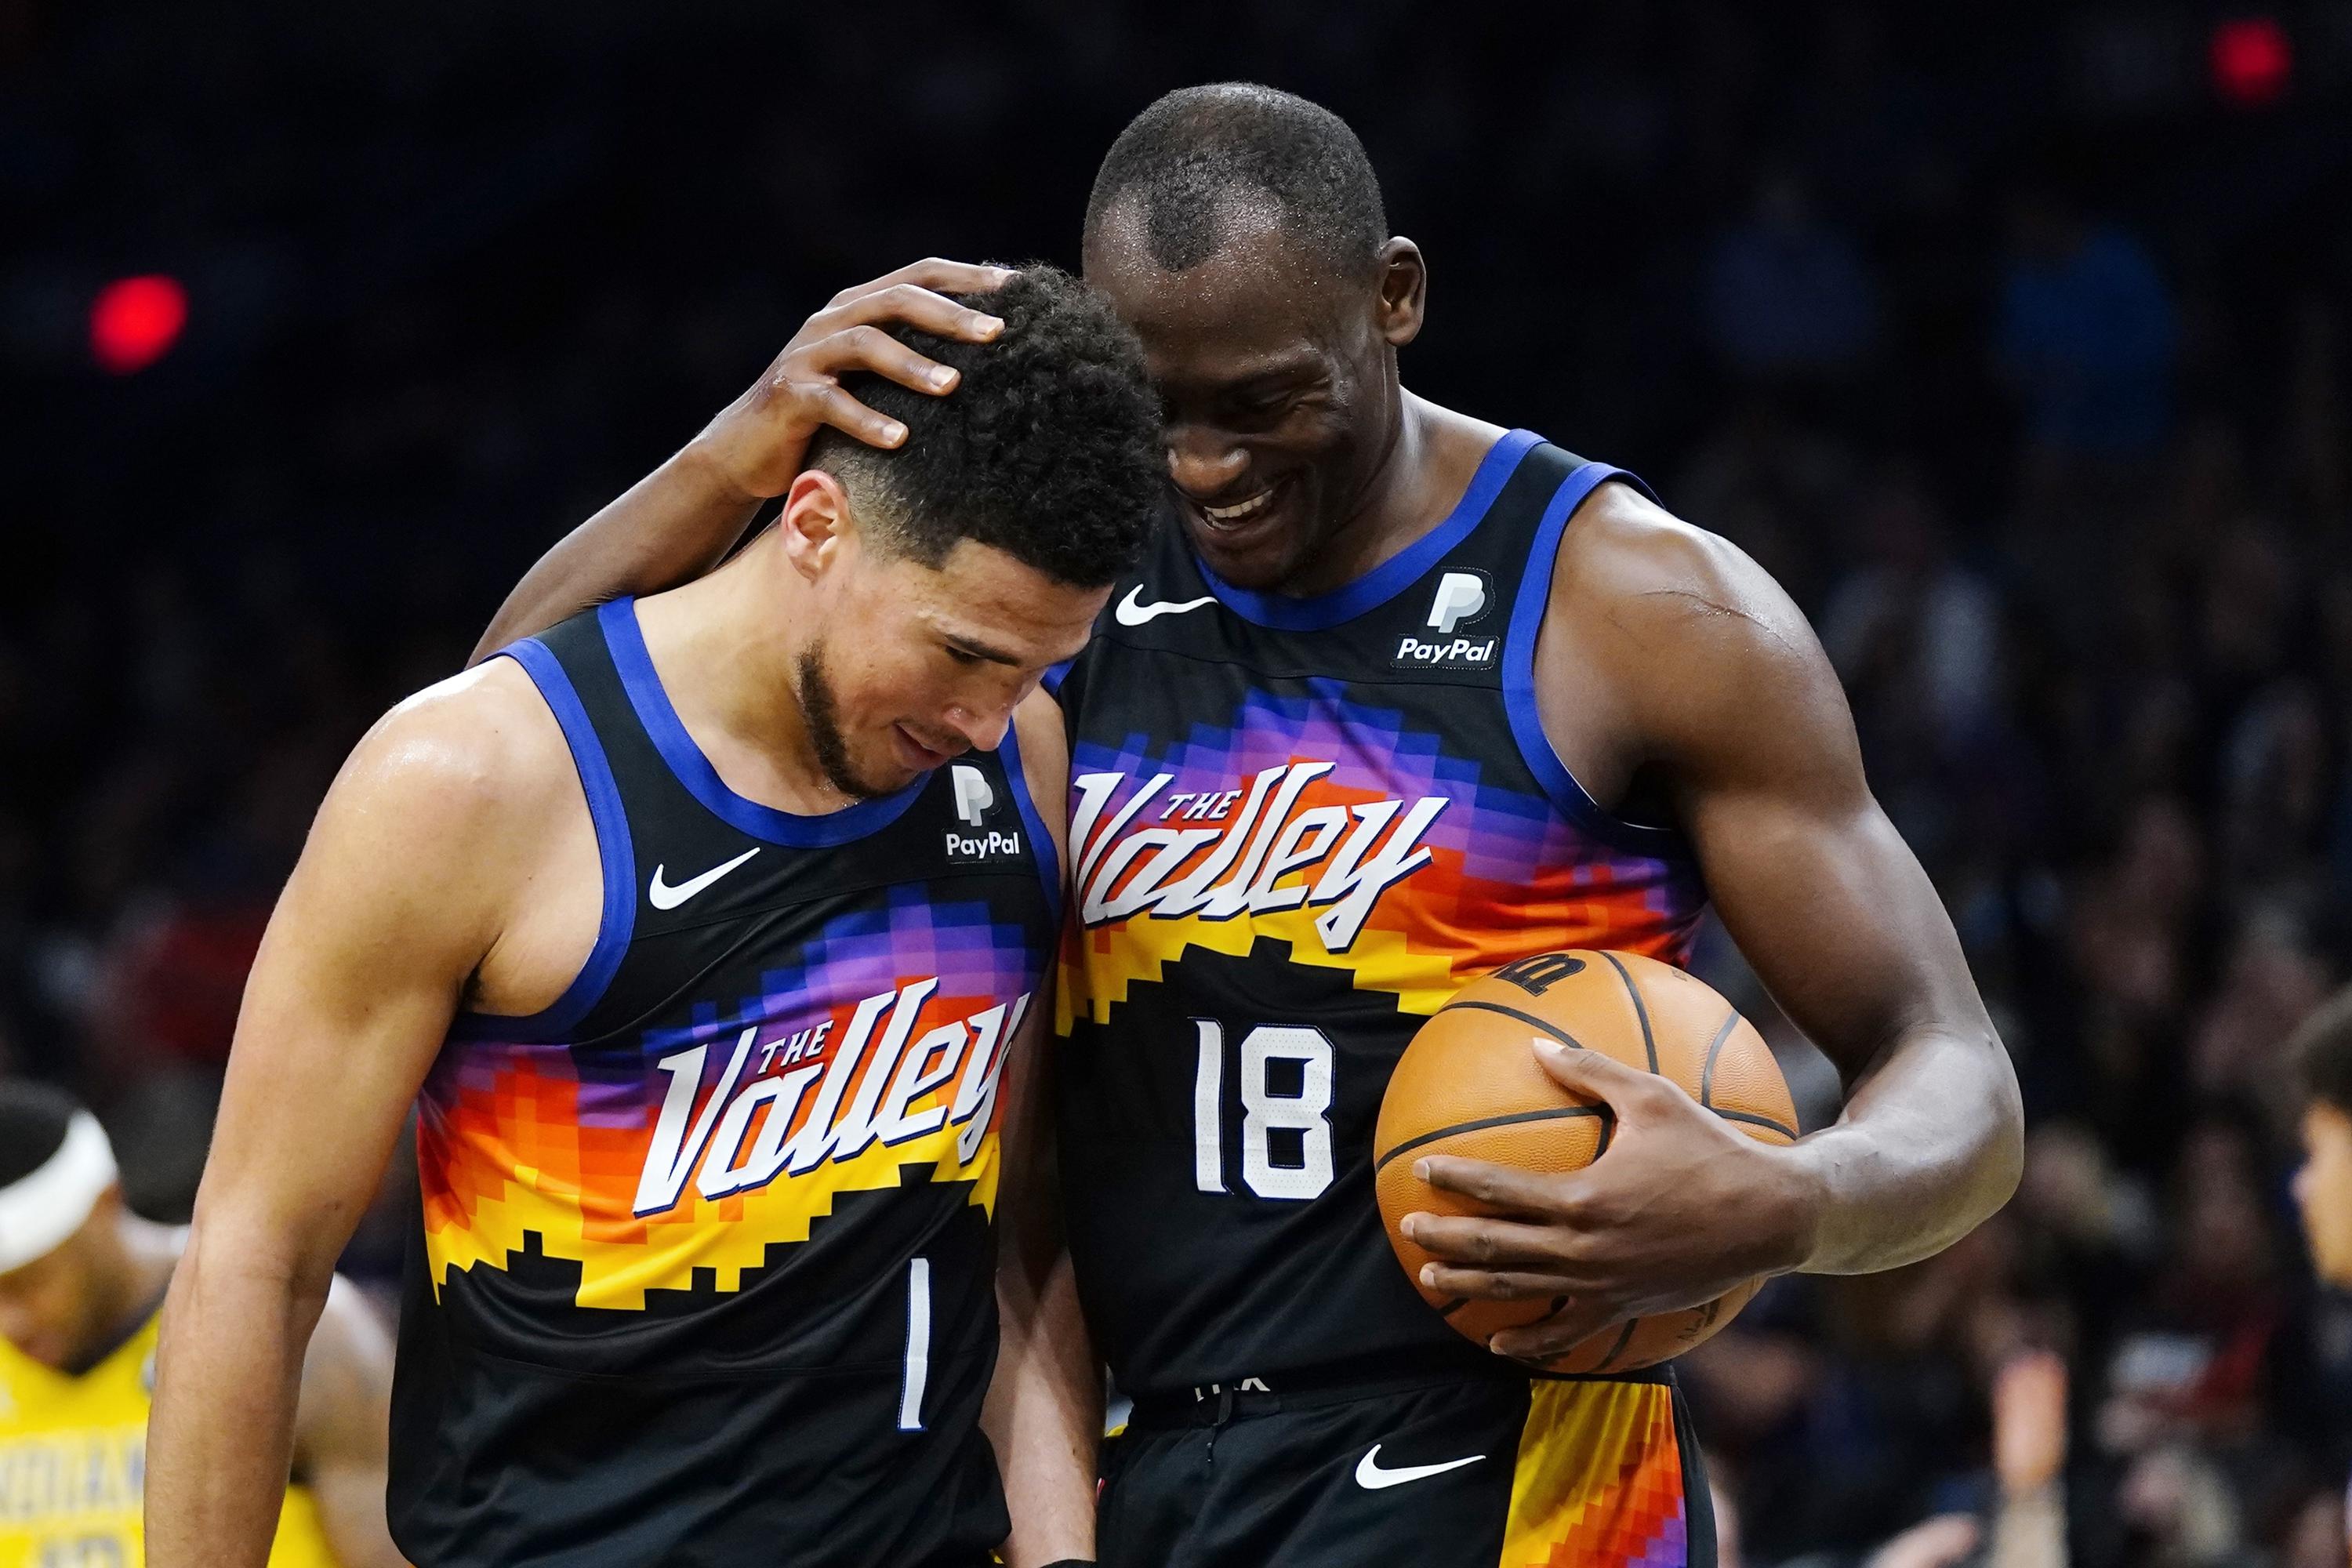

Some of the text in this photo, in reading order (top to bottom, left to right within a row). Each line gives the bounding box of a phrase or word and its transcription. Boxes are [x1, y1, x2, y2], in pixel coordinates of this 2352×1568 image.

[1397, 638, 1495, 663] PayPal
[946, 831, 1020, 859] PayPal
[1069, 762, 1450, 954] Valley
[1161, 789, 1242, 820] THE
[632, 977, 1031, 1219] Valley
[760, 1021, 833, 1073] THE
[1193, 1021, 1335, 1200] 18
[896, 1257, 931, 1432] 1
